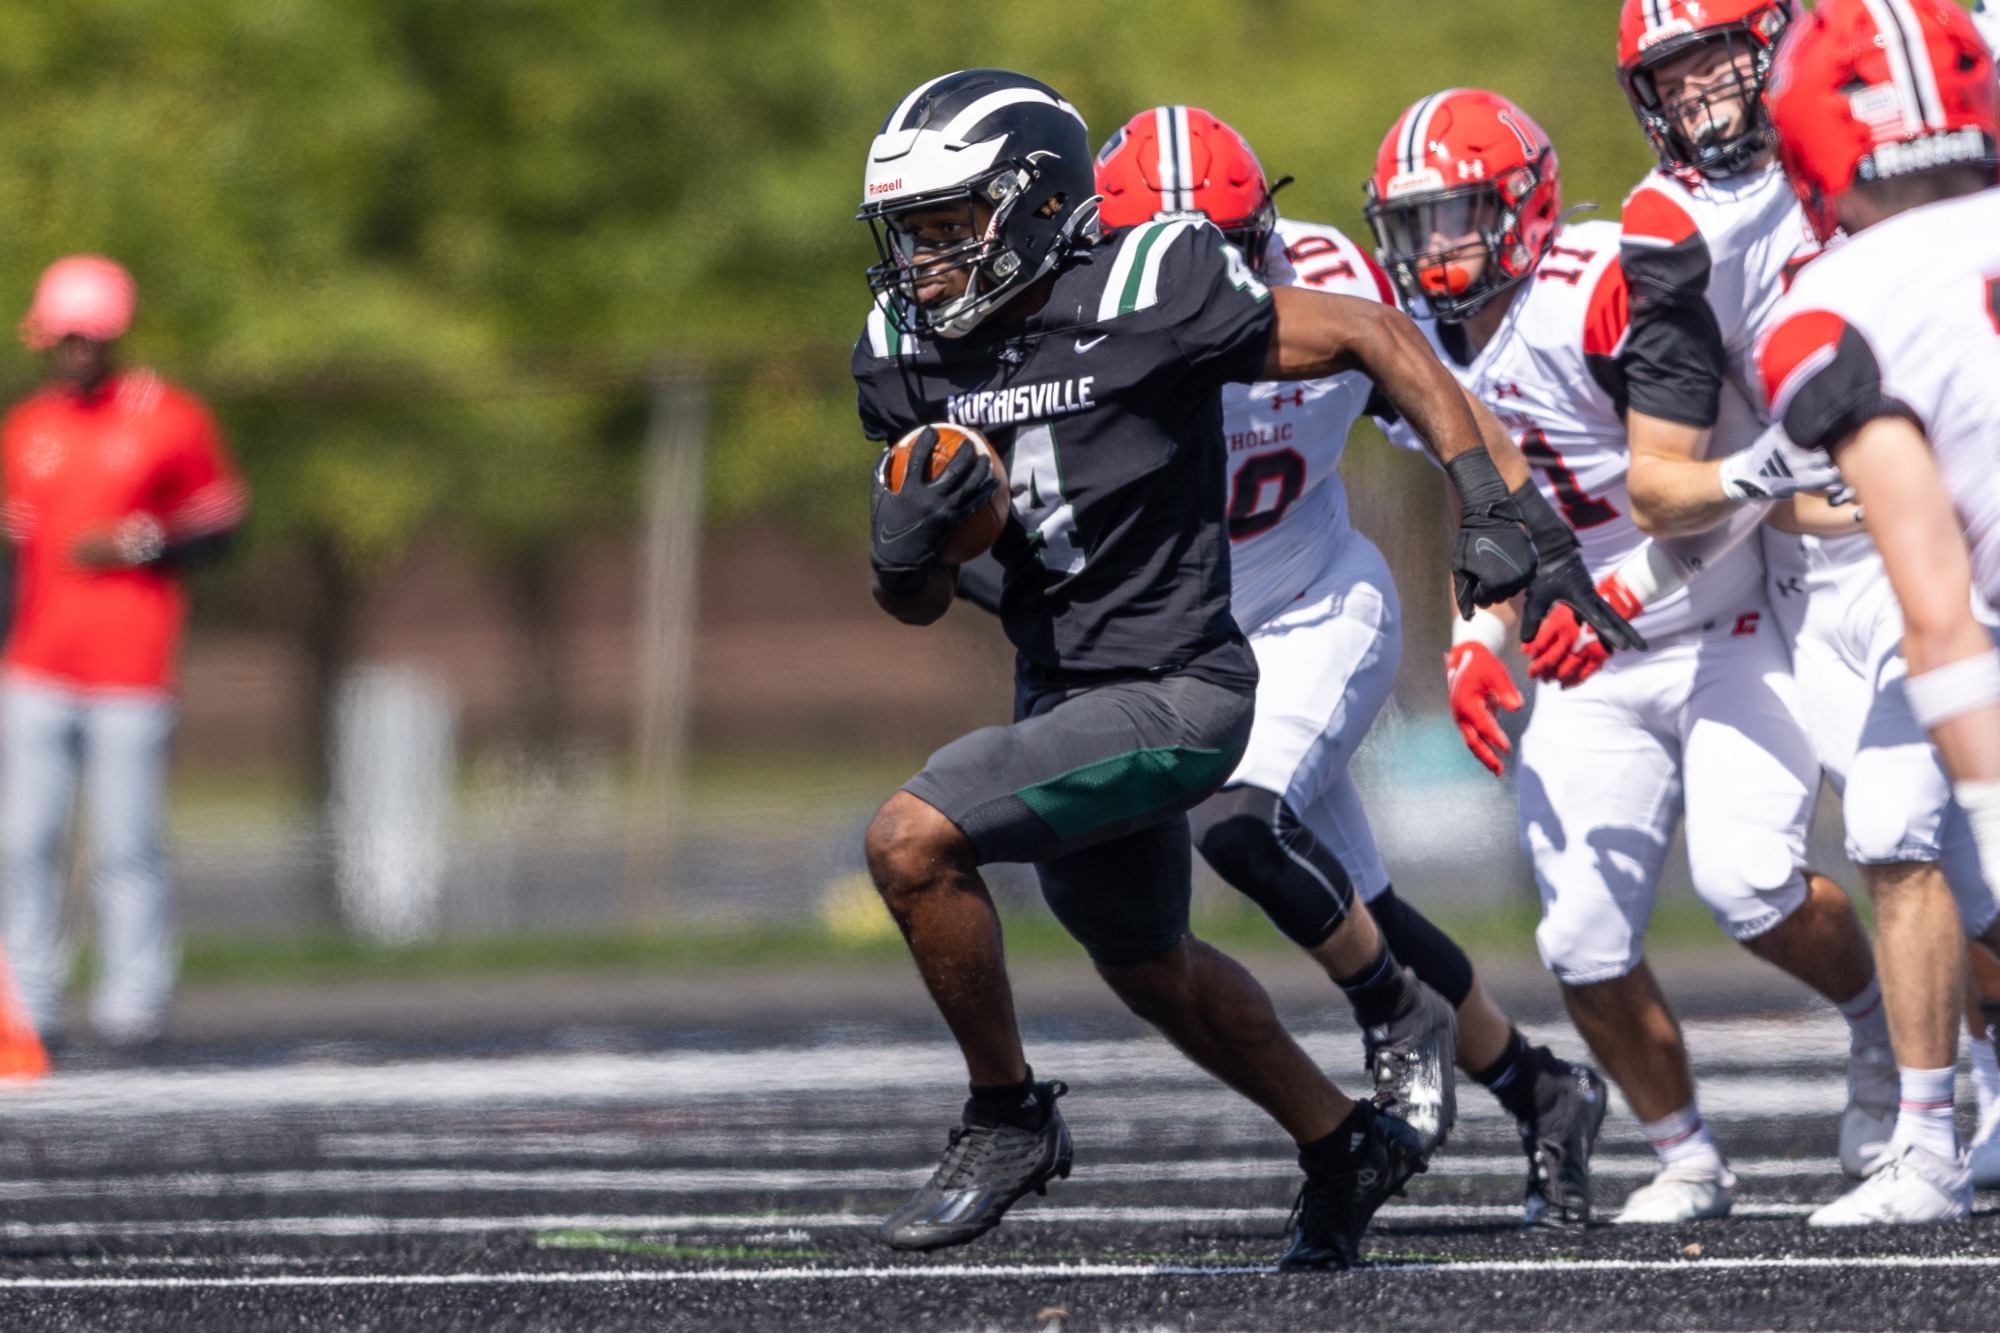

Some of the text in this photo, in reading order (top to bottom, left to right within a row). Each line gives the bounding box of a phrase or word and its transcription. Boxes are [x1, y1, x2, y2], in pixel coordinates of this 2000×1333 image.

[869, 178, 903, 195] Riddell
[1219, 243, 1271, 304] 4
[1283, 236, 1357, 286] 10
[1537, 245, 1597, 286] 11
[947, 375, 1096, 426] MORRISVILLE
[1226, 422, 1293, 452] HOLIC
[1009, 422, 1089, 576] 4
